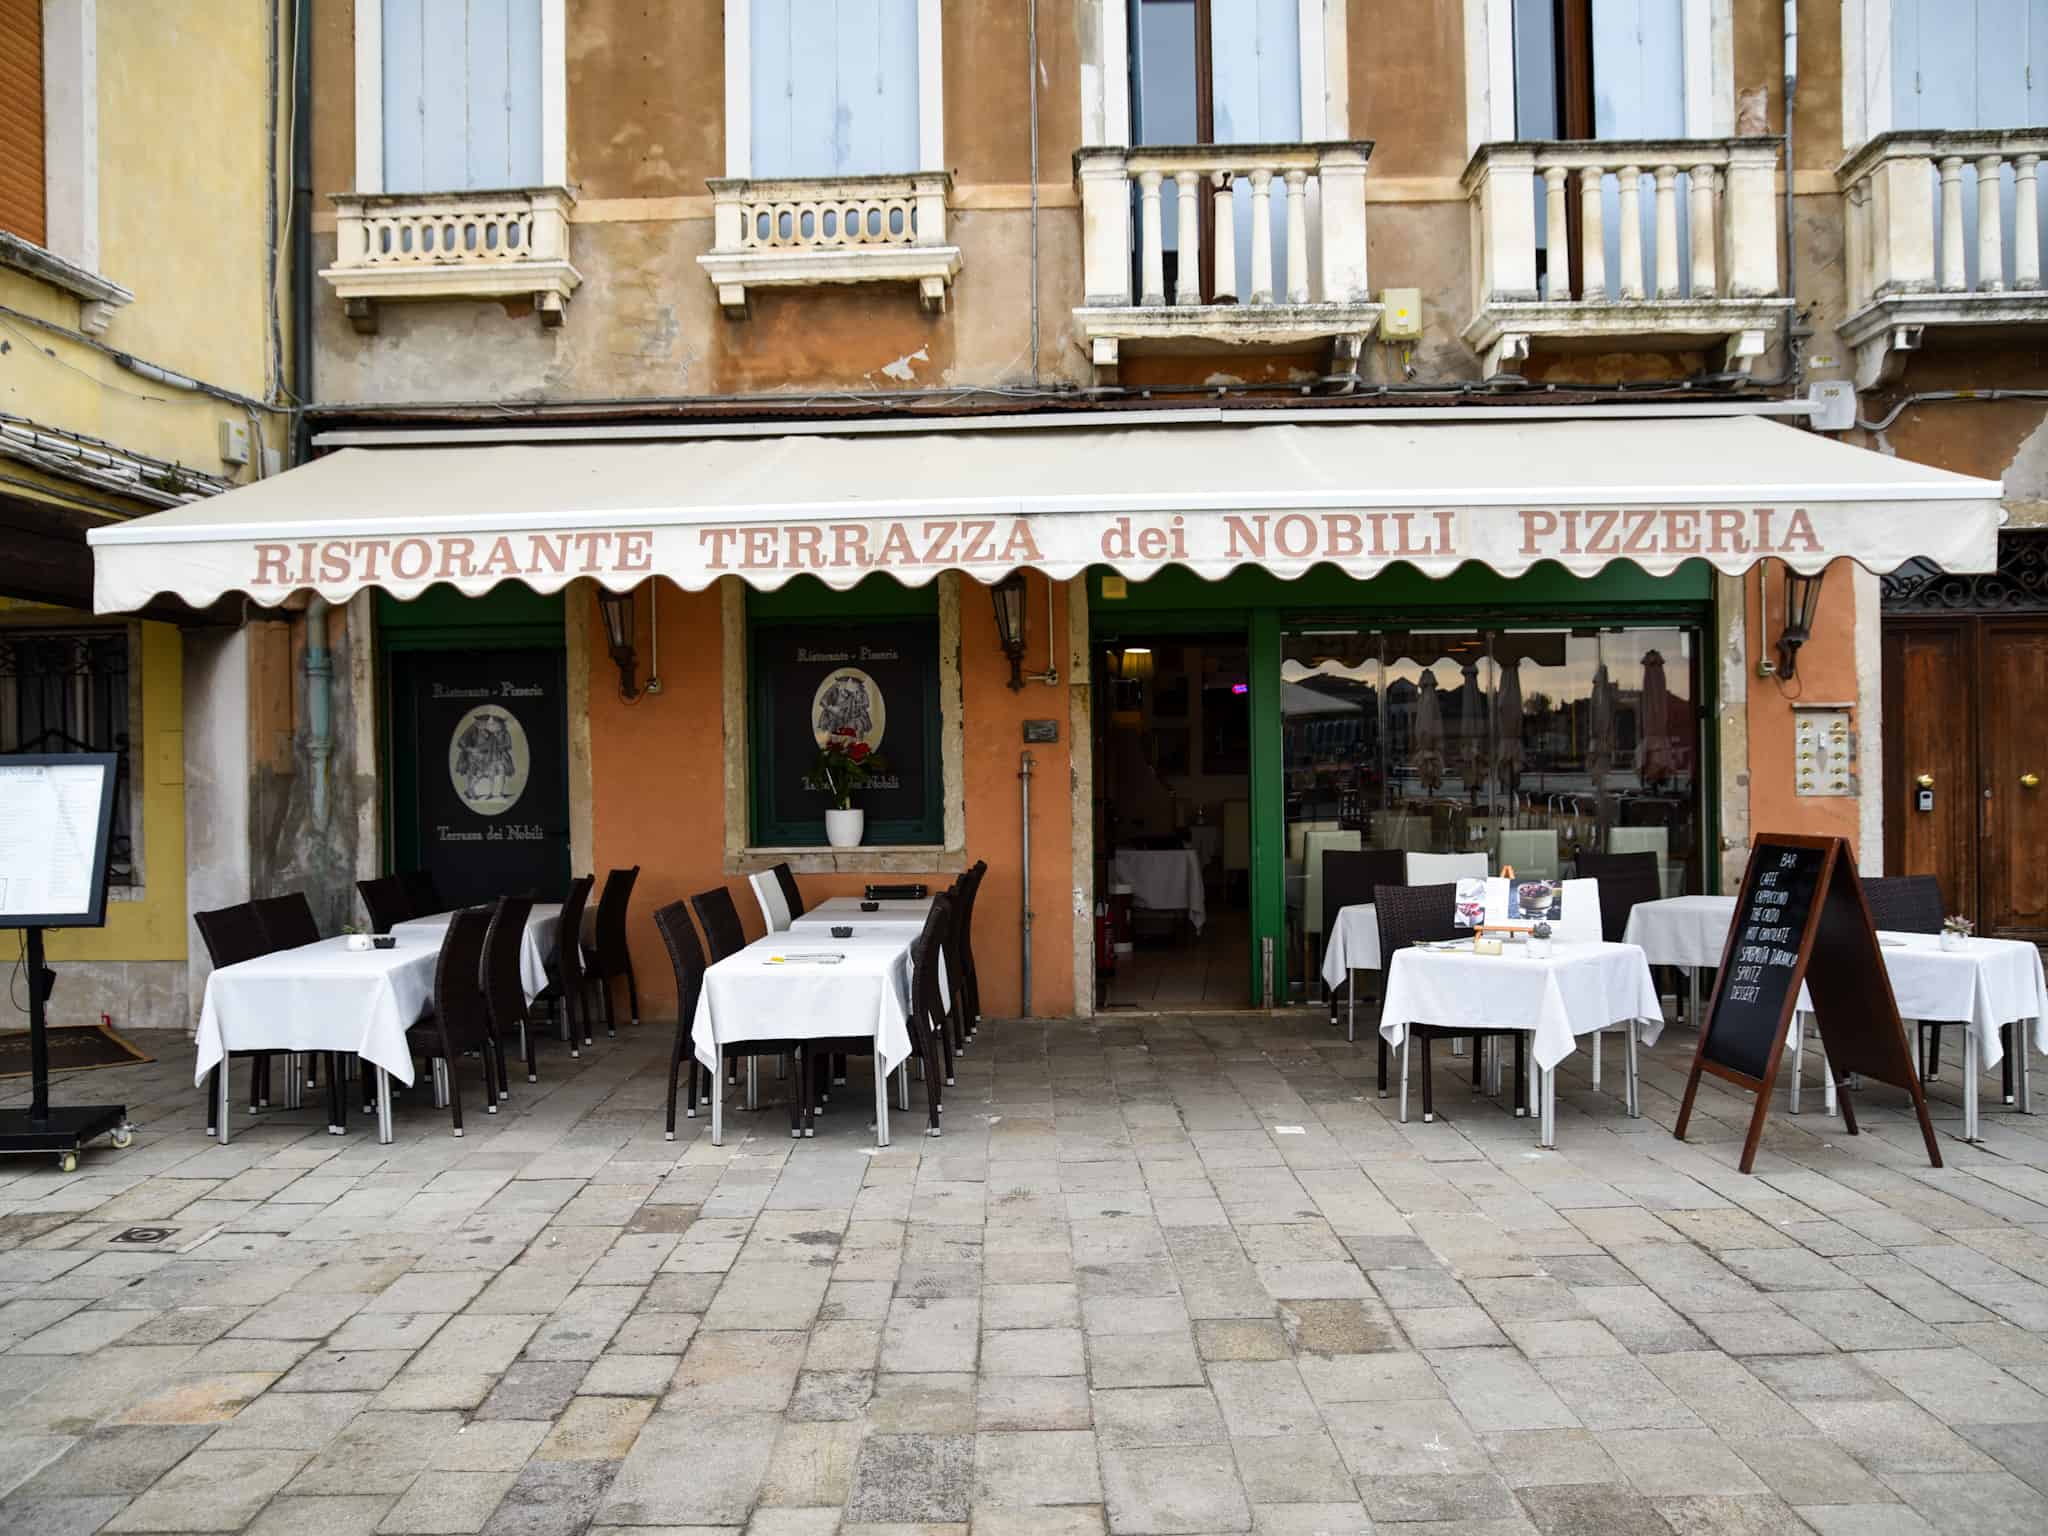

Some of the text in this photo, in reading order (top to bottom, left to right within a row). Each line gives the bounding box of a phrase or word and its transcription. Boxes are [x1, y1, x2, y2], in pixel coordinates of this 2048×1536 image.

[250, 508, 1826, 586] RISTORANTE TERRAZZA dei NOBILI PIZZERIA
[486, 824, 504, 841] dei
[505, 824, 545, 841] Nobili
[1779, 852, 1798, 868] BAR
[1745, 926, 1760, 941] HOT
[1735, 966, 1762, 983] SPRITZ
[1729, 985, 1760, 1004] DESSERT
